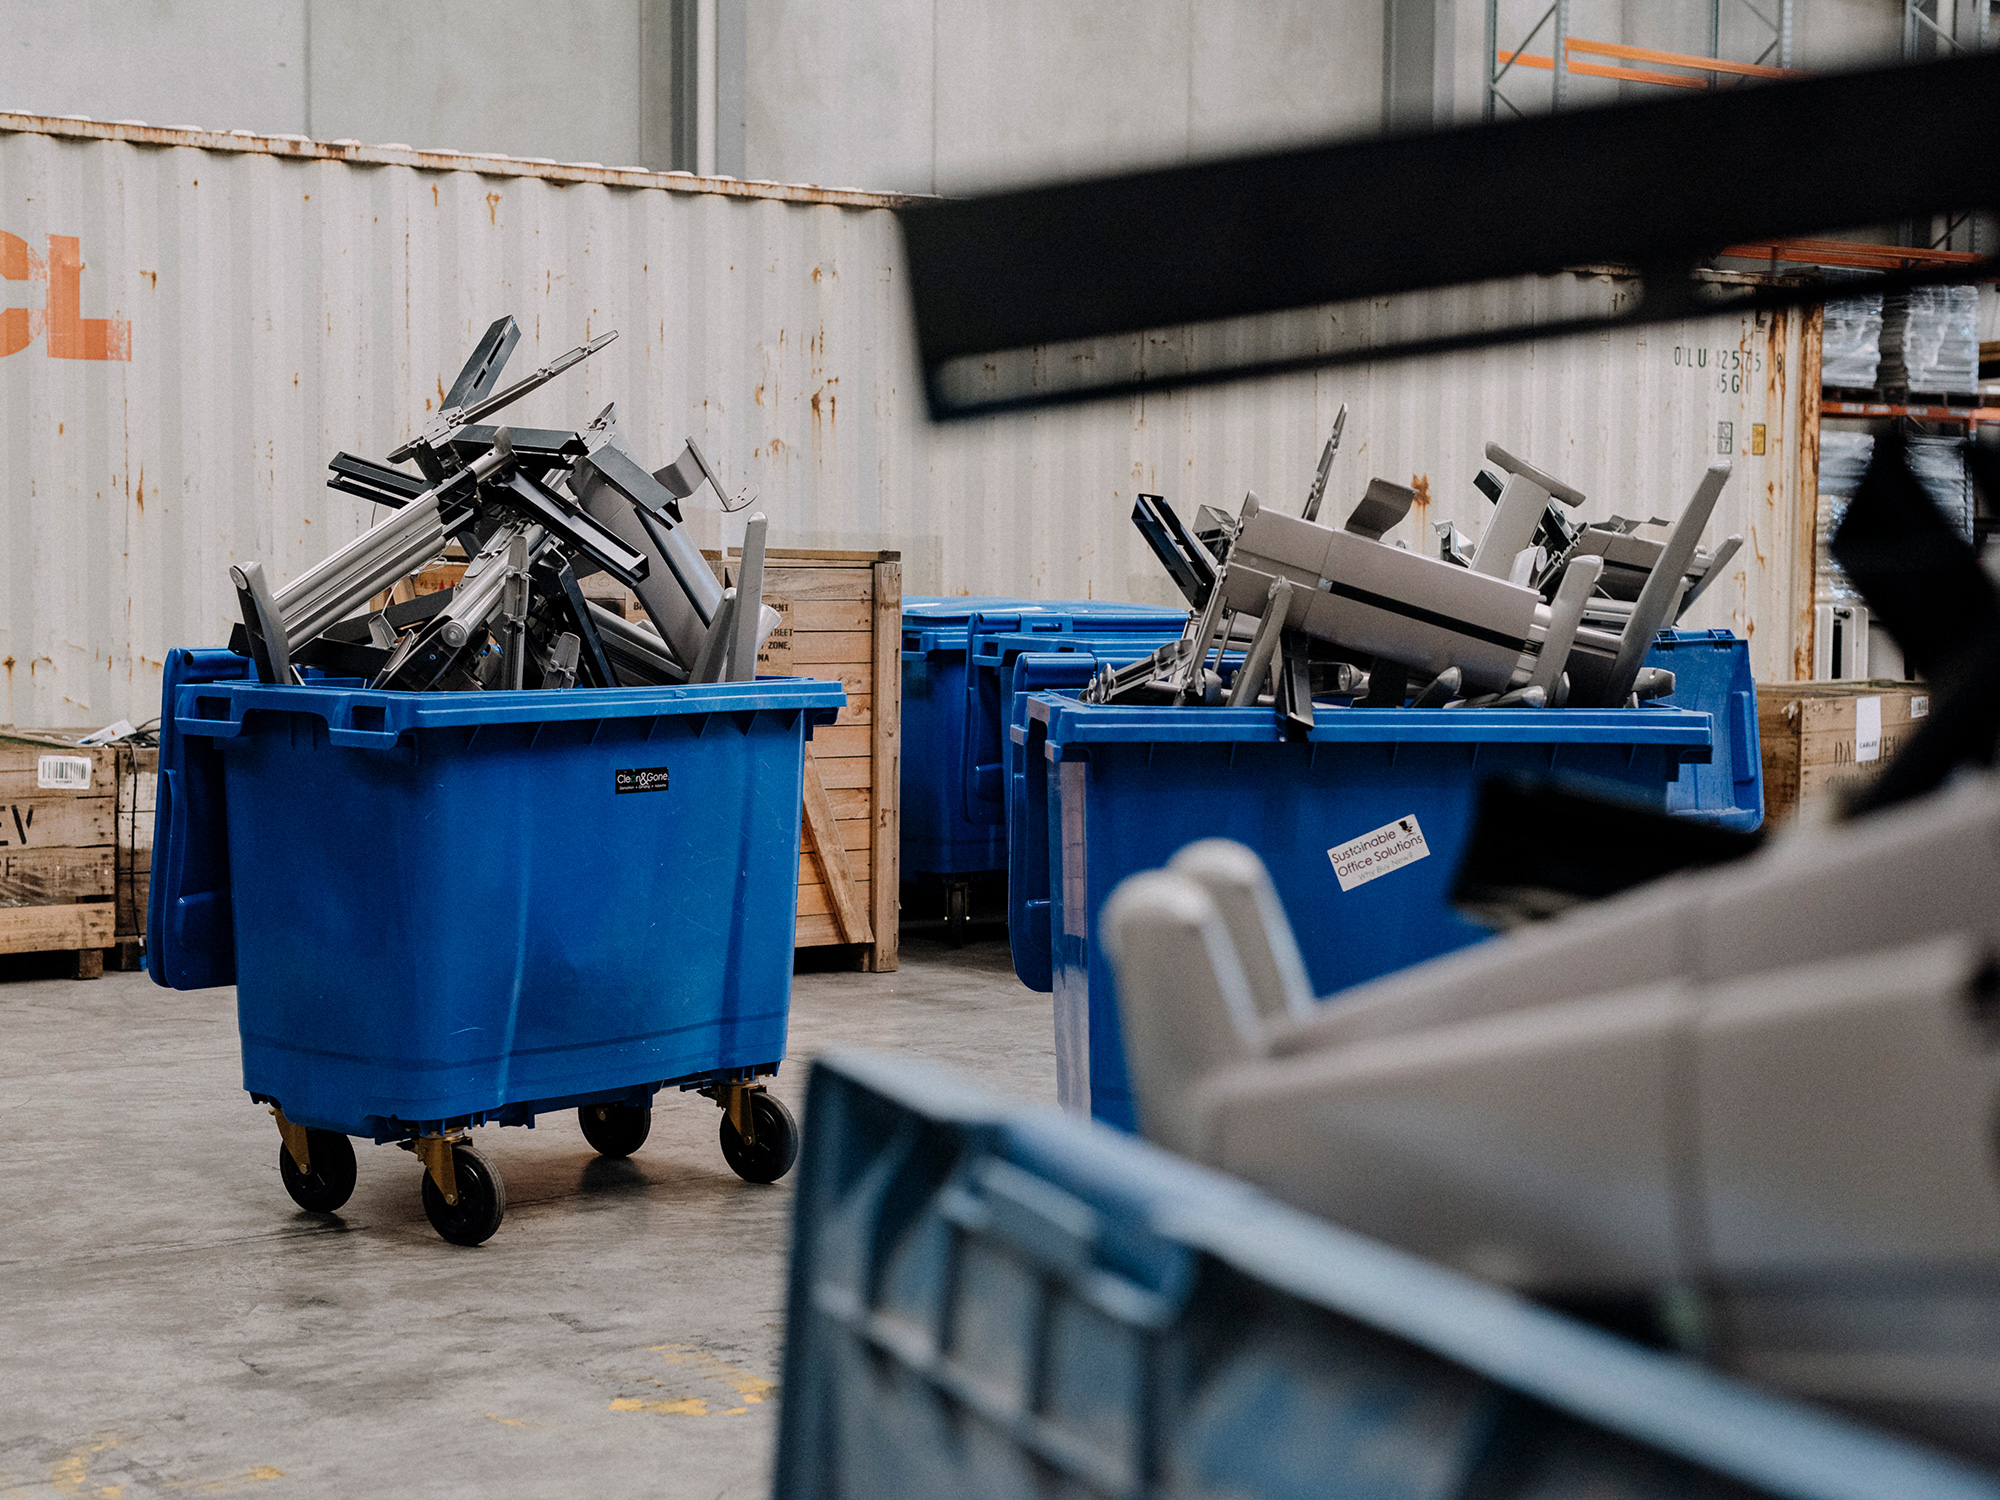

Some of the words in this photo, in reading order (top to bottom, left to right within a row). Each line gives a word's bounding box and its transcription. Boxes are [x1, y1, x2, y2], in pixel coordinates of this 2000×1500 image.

[1331, 830, 1397, 864] Sustainable
[1337, 857, 1373, 877] Office
[1374, 835, 1423, 862] Solutions
